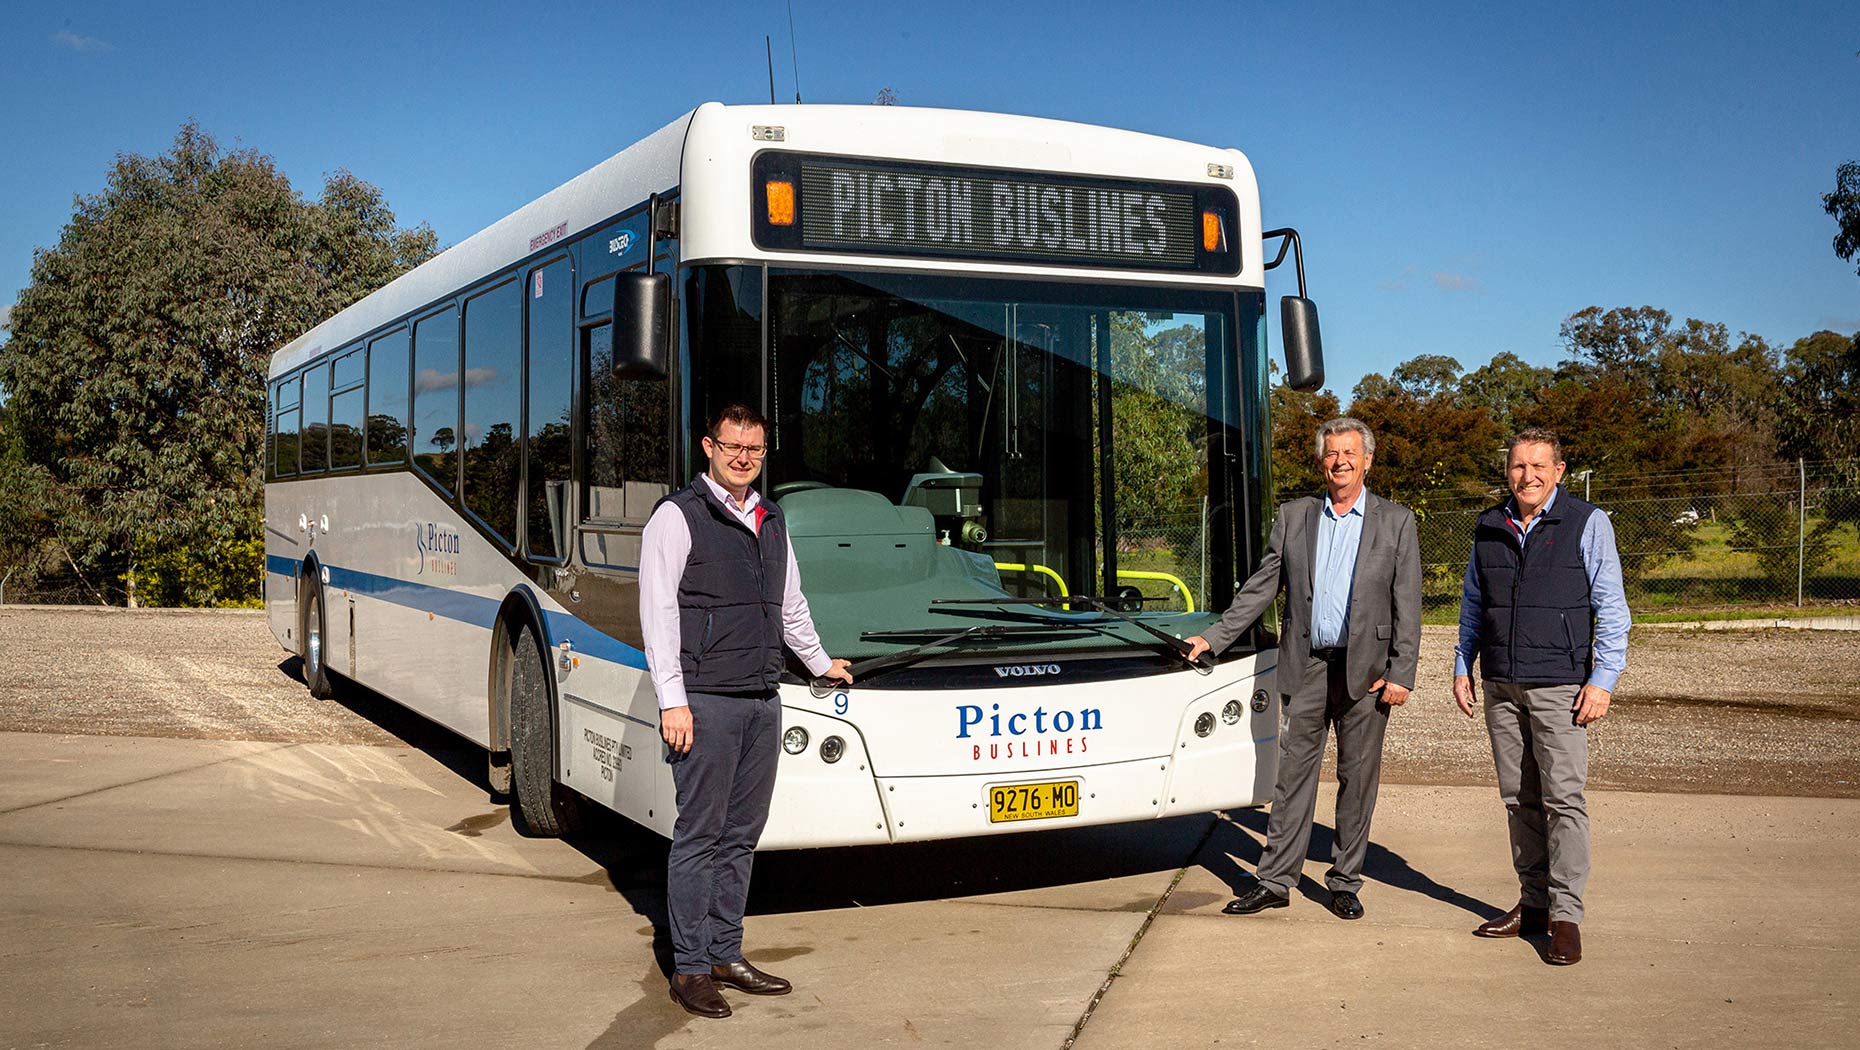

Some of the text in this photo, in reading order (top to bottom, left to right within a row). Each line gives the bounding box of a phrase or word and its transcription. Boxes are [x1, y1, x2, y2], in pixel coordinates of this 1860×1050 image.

[832, 172, 1166, 256] PICTON BUSLINES
[529, 222, 568, 251] EMERGENCY EXIT
[428, 523, 459, 554] Picton
[431, 559, 457, 576] BUSLINES
[994, 664, 1062, 678] VOLVO
[834, 693, 849, 715] 9
[956, 703, 1103, 738] Picton
[973, 737, 1087, 761] BUSLINES
